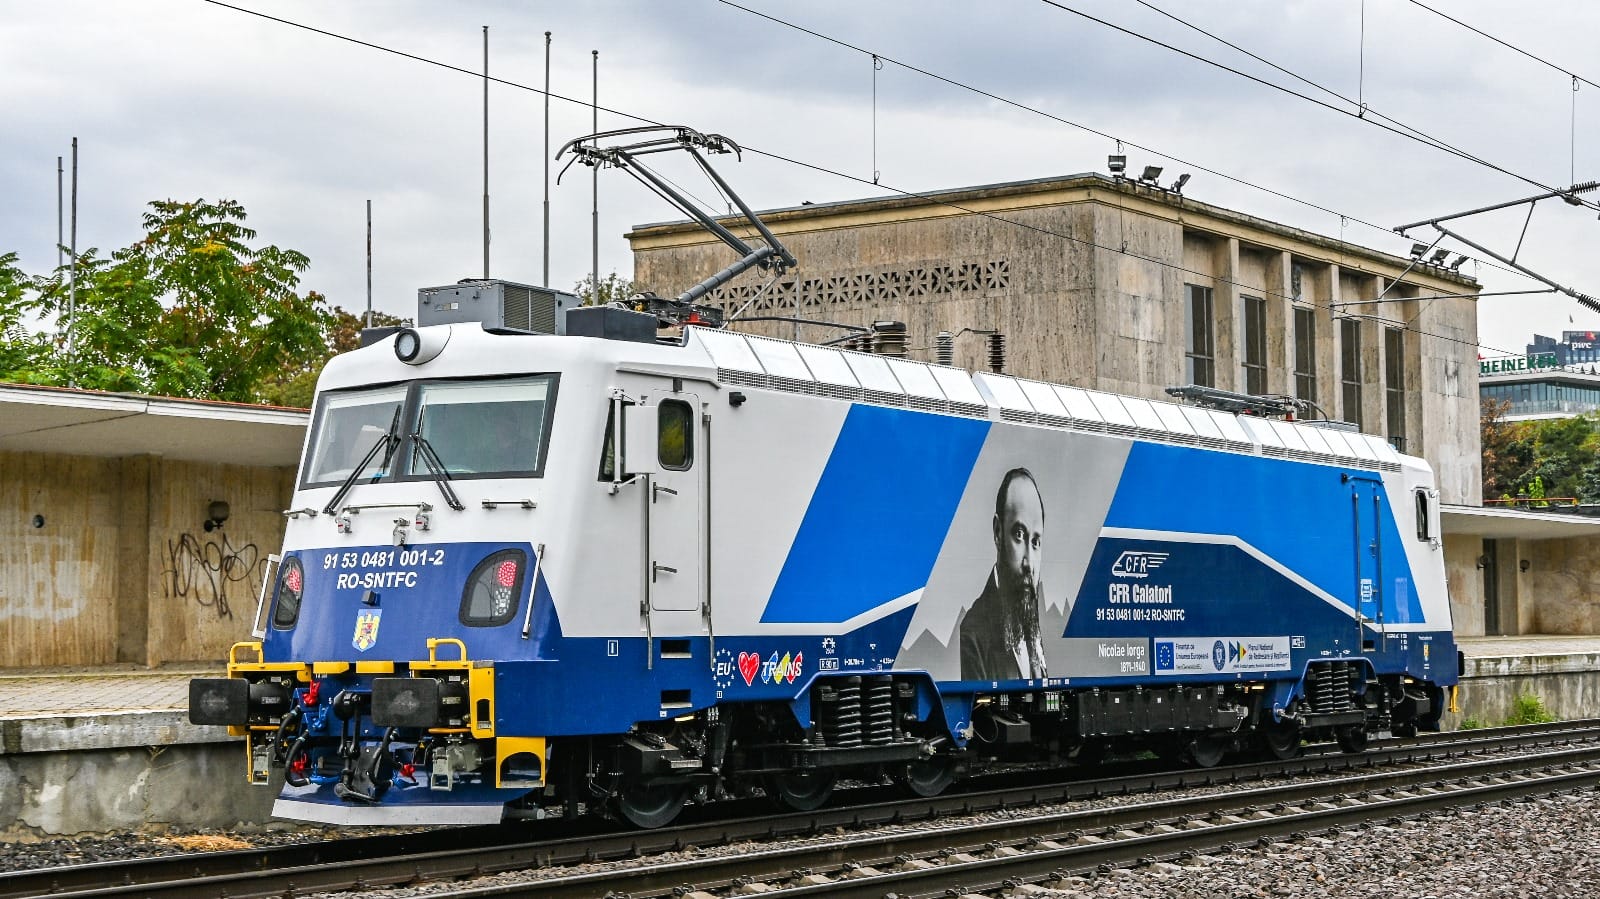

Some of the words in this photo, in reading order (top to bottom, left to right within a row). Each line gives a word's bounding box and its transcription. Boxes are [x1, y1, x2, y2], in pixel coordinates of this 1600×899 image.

[1572, 342, 1592, 350] pwc
[1480, 355, 1557, 373] HEINEKEN
[323, 553, 338, 569] 91
[341, 552, 358, 568] 53
[361, 551, 395, 567] 0481
[399, 549, 445, 566] 001-2
[1125, 556, 1147, 573] CFR
[336, 571, 418, 590] RO-SNTFC
[1109, 583, 1130, 604] CFR
[1132, 583, 1172, 604] Calatori
[1096, 608, 1105, 620] 91
[1106, 608, 1115, 620] 53
[1116, 608, 1132, 621] 0481
[1133, 609, 1151, 621] 001-2
[1151, 609, 1185, 621] RO-SNTFC
[1098, 643, 1125, 658] Nicolae
[1126, 644, 1145, 659] Iorga
[717, 662, 731, 676] EU
[762, 661, 803, 677] TRAINS
